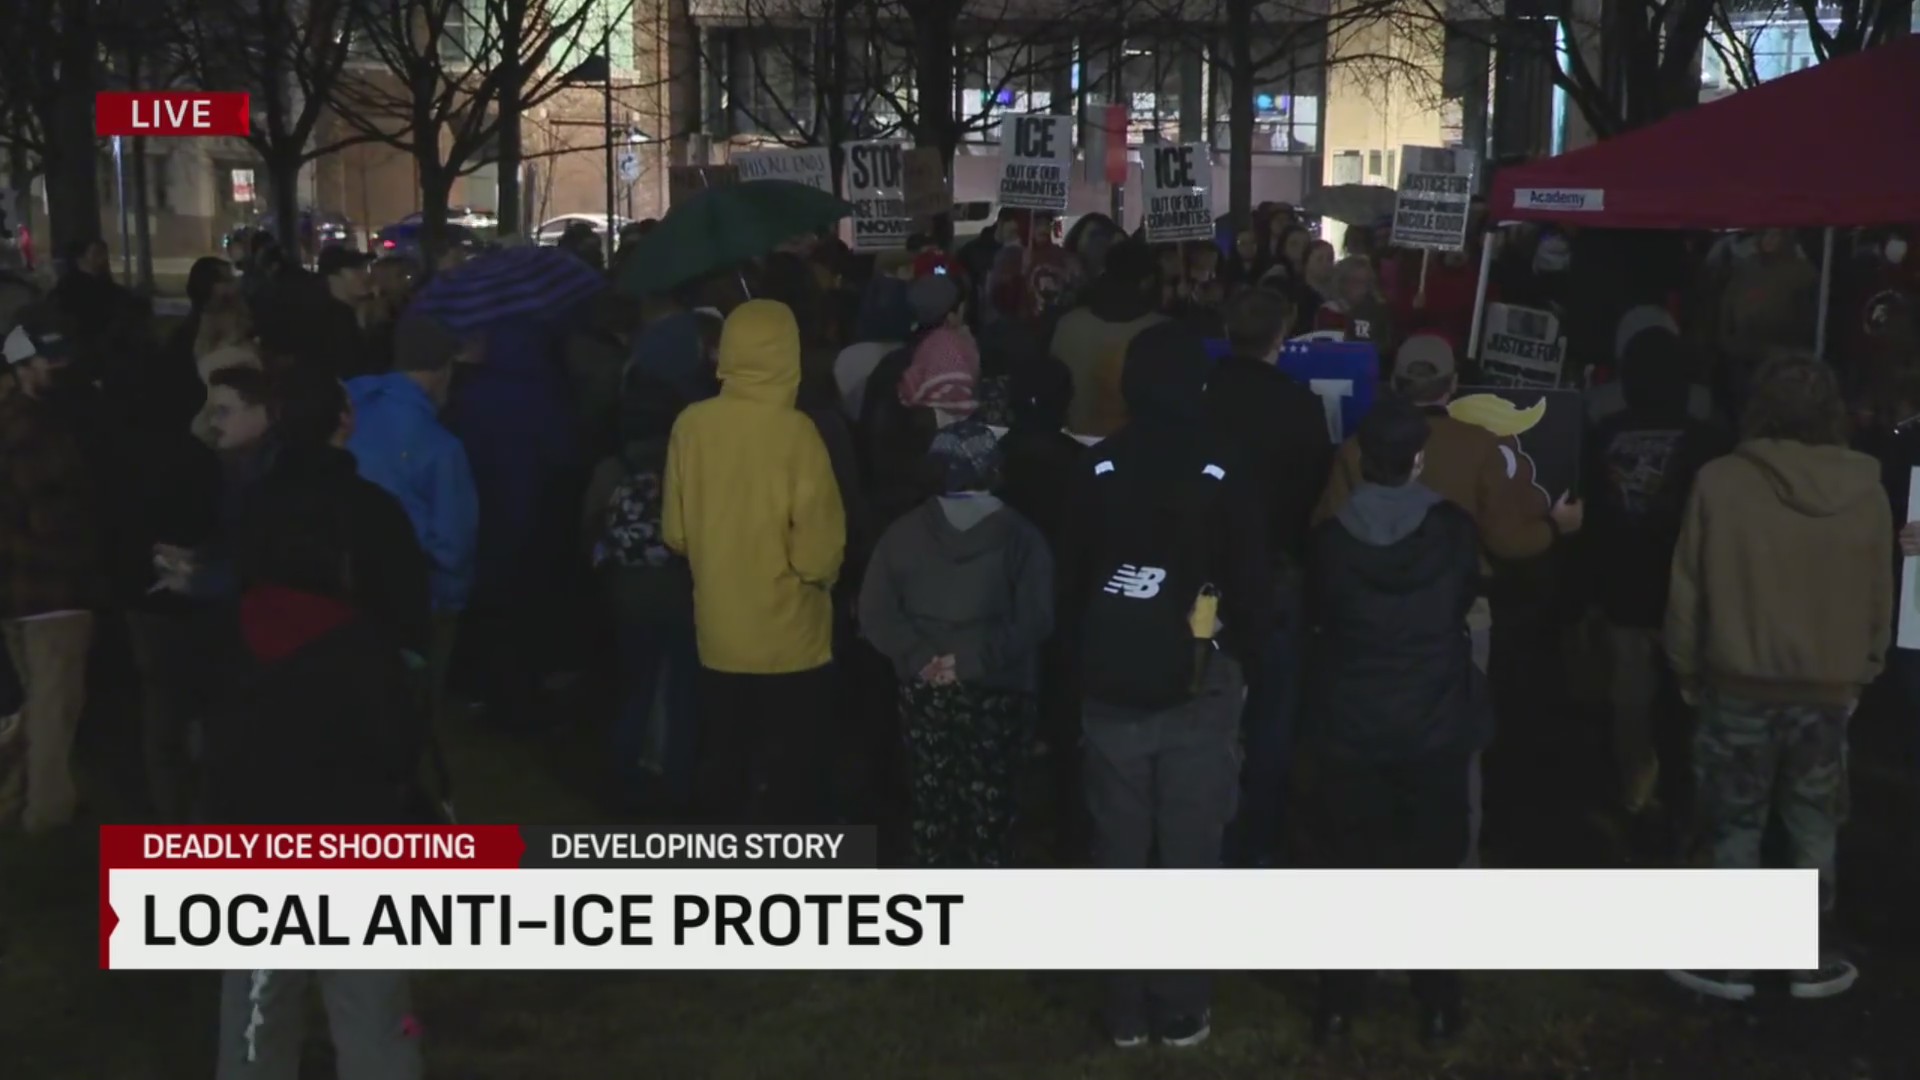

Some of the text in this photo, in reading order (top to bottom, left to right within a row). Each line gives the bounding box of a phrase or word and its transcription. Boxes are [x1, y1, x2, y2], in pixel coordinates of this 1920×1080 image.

[1015, 116, 1056, 158] ICE
[1006, 164, 1061, 182] OUT OF OUR
[1154, 146, 1196, 189] ICE
[1001, 179, 1067, 197] COMMUNITIES
[1151, 193, 1204, 213] OUT OF OUR
[1529, 190, 1586, 208] Academy
